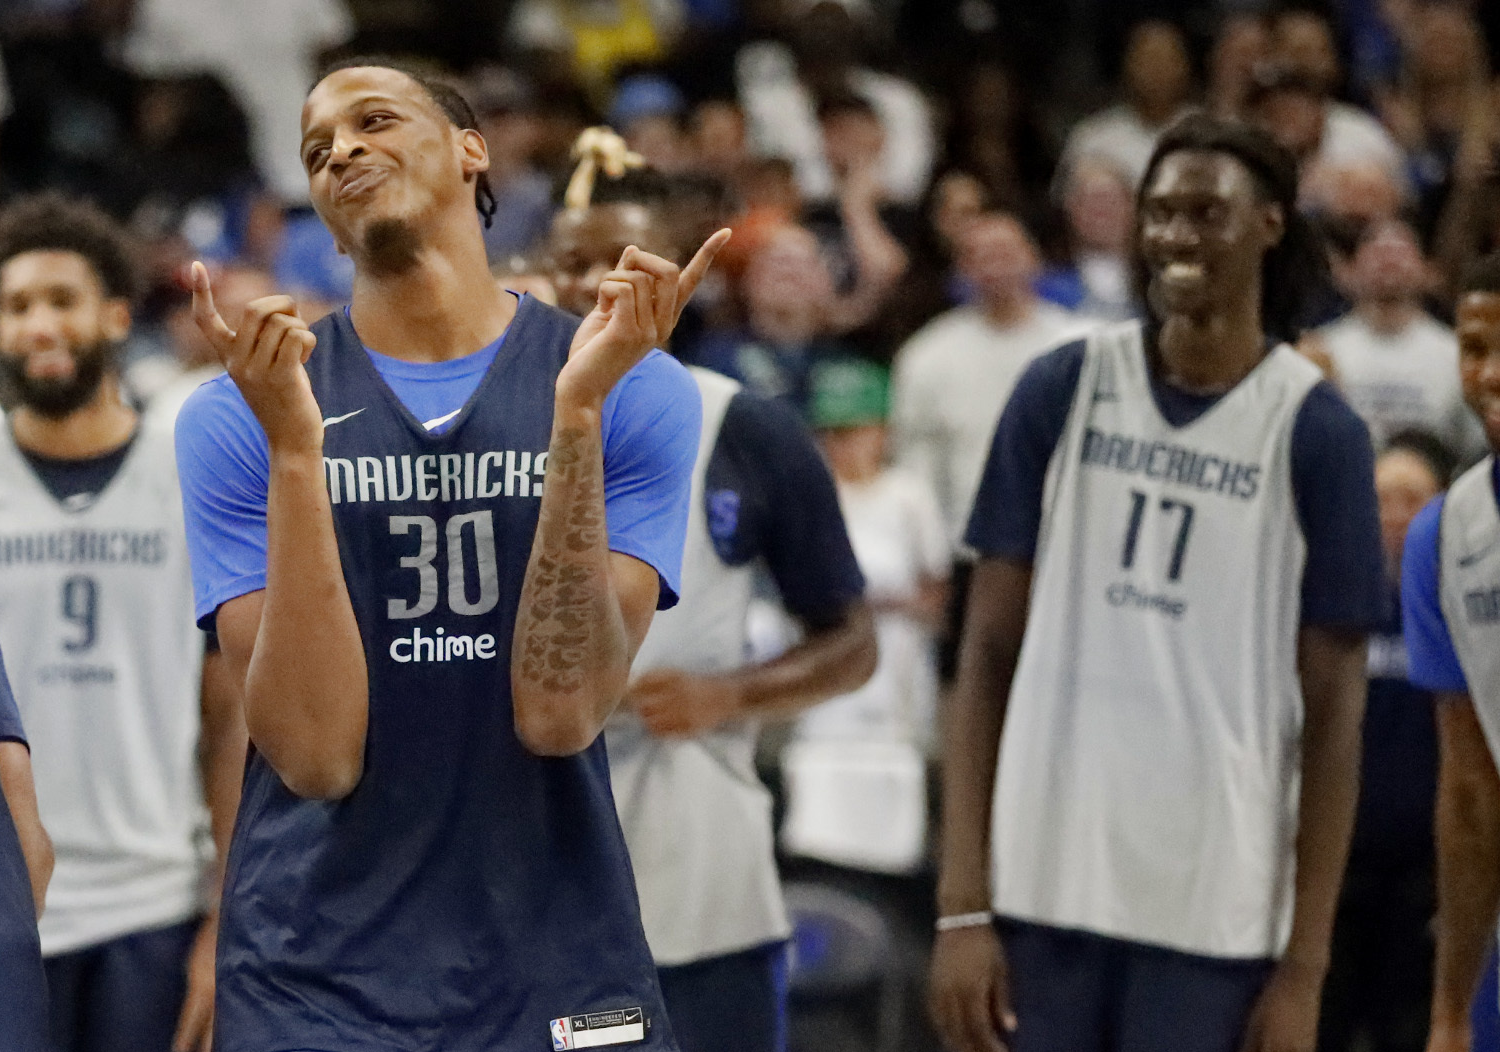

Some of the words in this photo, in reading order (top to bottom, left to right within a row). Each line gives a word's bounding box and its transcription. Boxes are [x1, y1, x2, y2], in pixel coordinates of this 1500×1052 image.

[387, 510, 499, 619] 30
[1121, 489, 1194, 580] 17
[60, 574, 100, 654] 9
[389, 627, 496, 663] chime
[574, 1020, 585, 1028] XL
